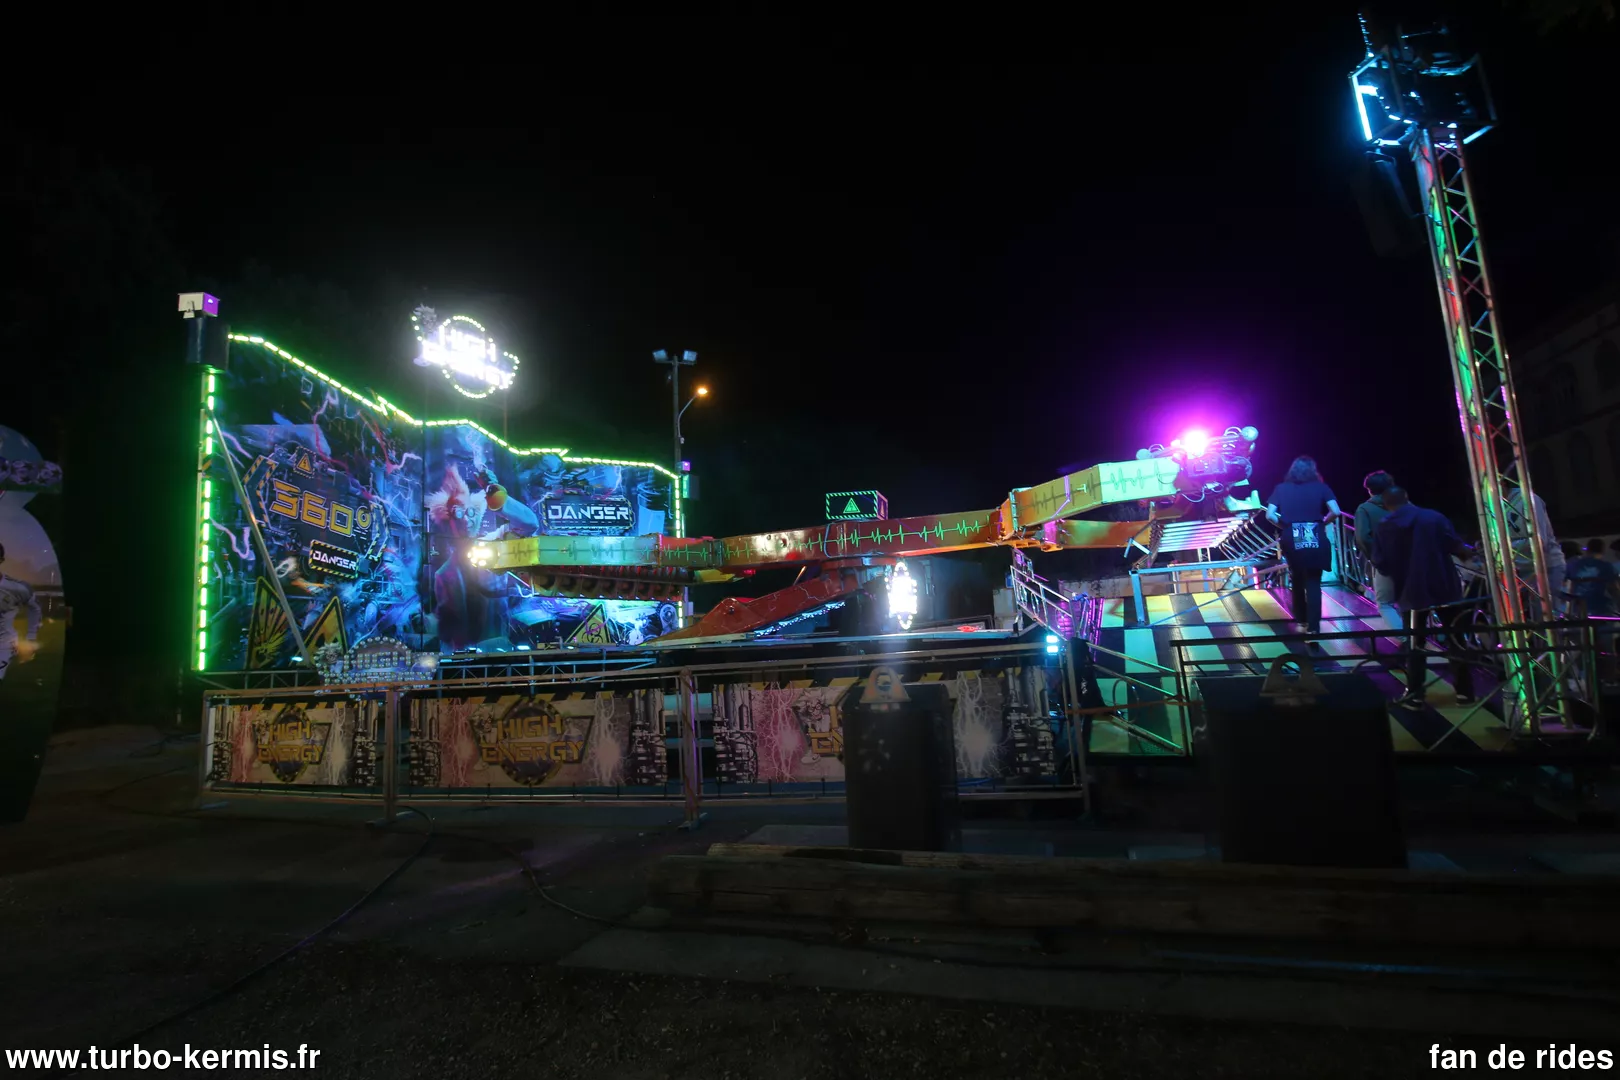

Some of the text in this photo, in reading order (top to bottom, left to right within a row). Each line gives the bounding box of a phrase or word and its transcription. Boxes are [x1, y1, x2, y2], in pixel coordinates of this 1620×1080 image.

[547, 505, 629, 520] DANGER
[312, 550, 358, 571] DANGER
[269, 719, 312, 742] HIGH
[496, 713, 564, 741] HIGH
[257, 742, 324, 764] ENERGY
[480, 740, 585, 764] ENERGY
